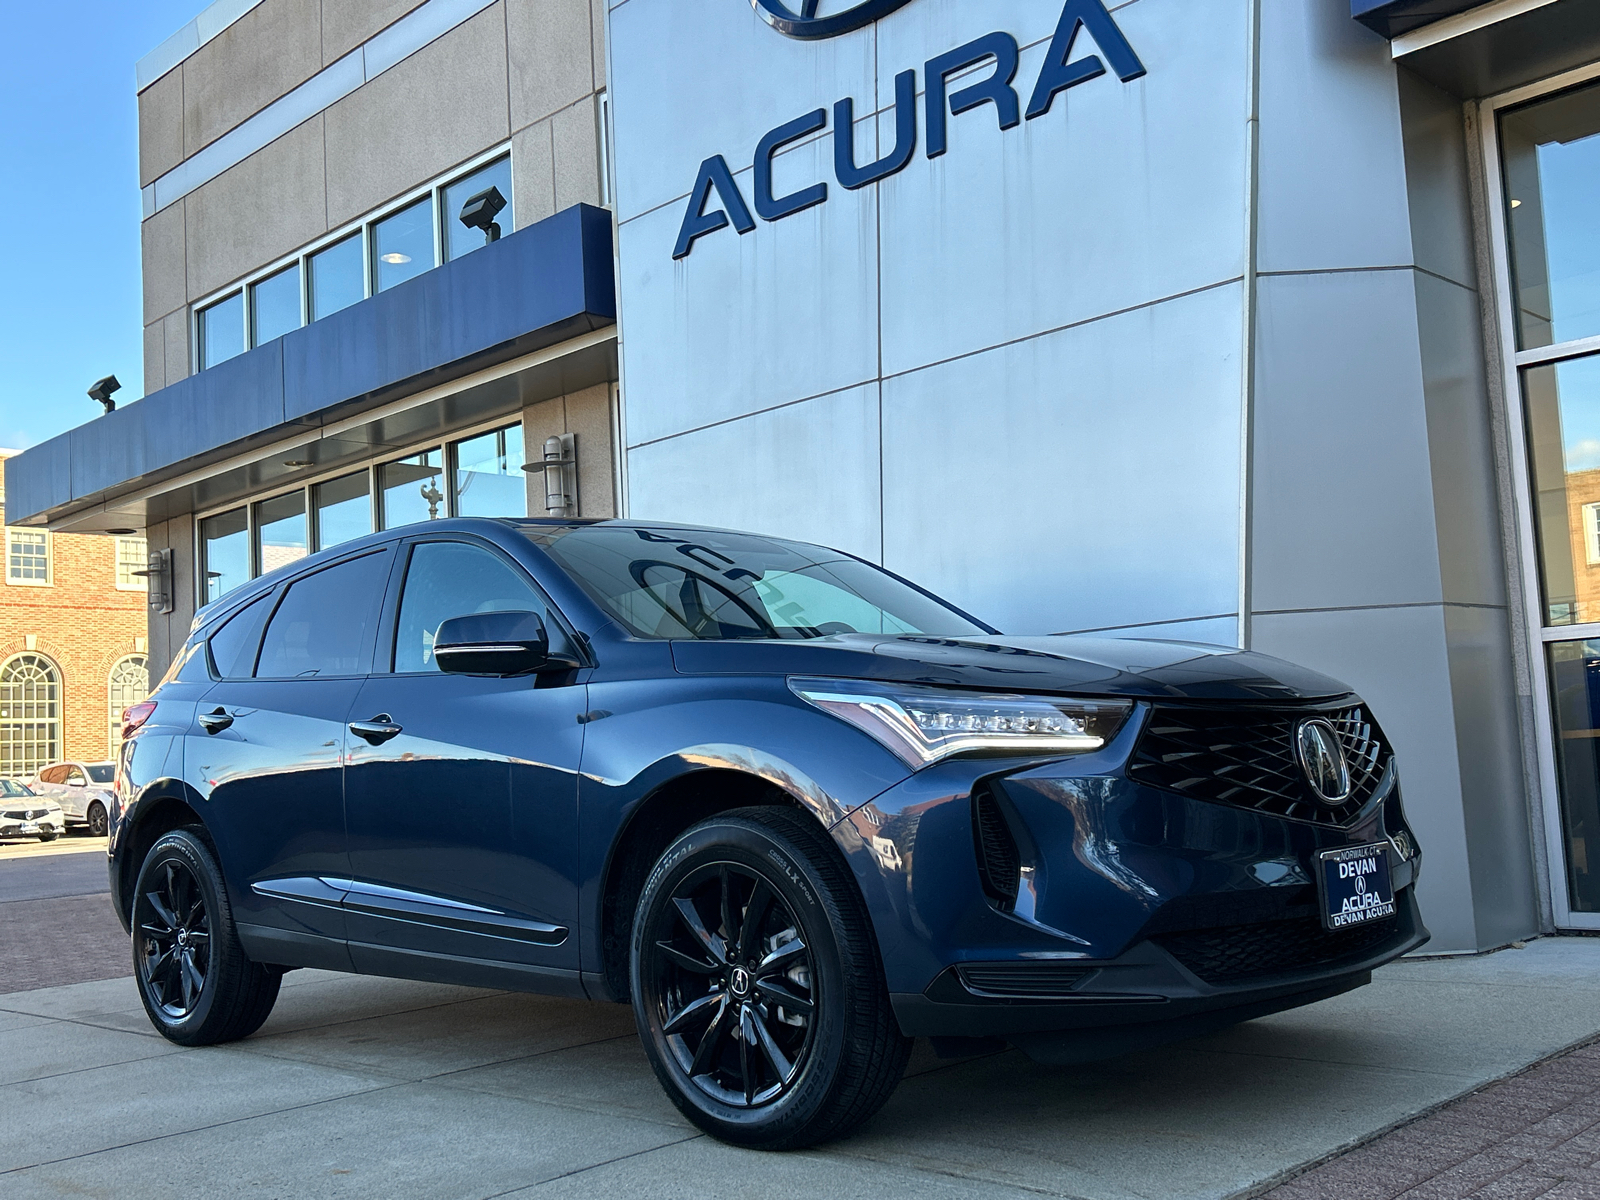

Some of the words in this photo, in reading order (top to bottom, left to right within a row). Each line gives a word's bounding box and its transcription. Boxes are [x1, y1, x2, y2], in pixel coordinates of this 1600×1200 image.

[672, 0, 1147, 261] ACURA
[1341, 849, 1368, 861] NORWALK
[785, 865, 800, 884] LX
[1338, 857, 1377, 879] DEVAN
[1341, 891, 1382, 913] ACURA
[1333, 911, 1364, 927] DEVAN
[1366, 904, 1394, 919] ACURA
